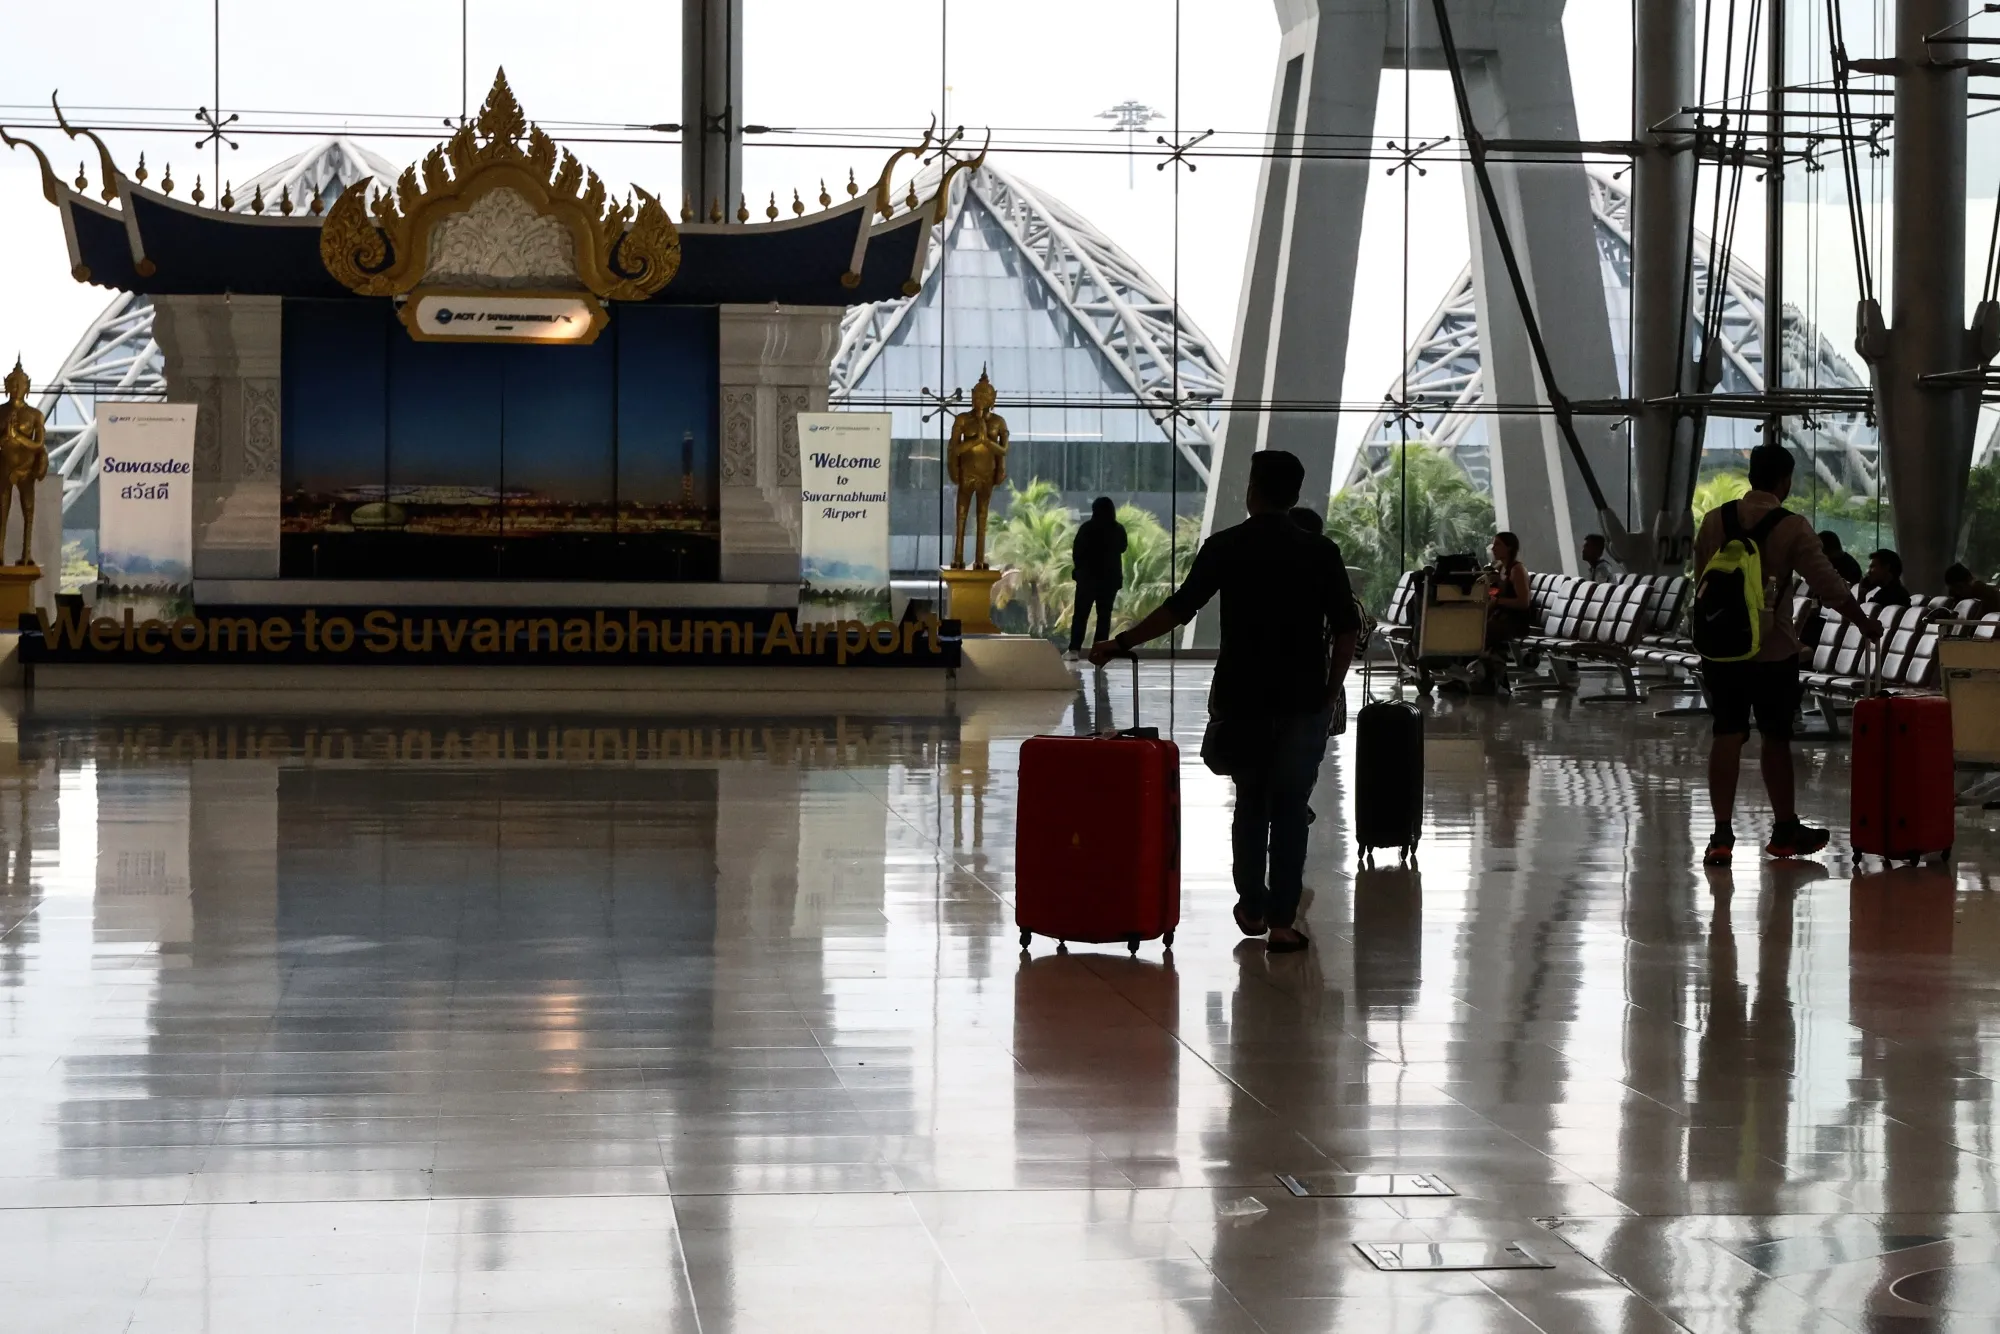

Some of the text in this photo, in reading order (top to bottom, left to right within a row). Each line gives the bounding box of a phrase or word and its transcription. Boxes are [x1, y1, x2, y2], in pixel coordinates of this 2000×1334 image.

[103, 456, 190, 473] Sawasdee
[809, 453, 882, 468] Welcome
[836, 475, 849, 485] to
[121, 482, 169, 499] สวัสดี
[802, 491, 887, 502] Suvarnabhumi
[822, 507, 867, 522] Airport
[36, 605, 293, 654] Welcome
[302, 607, 355, 653] to
